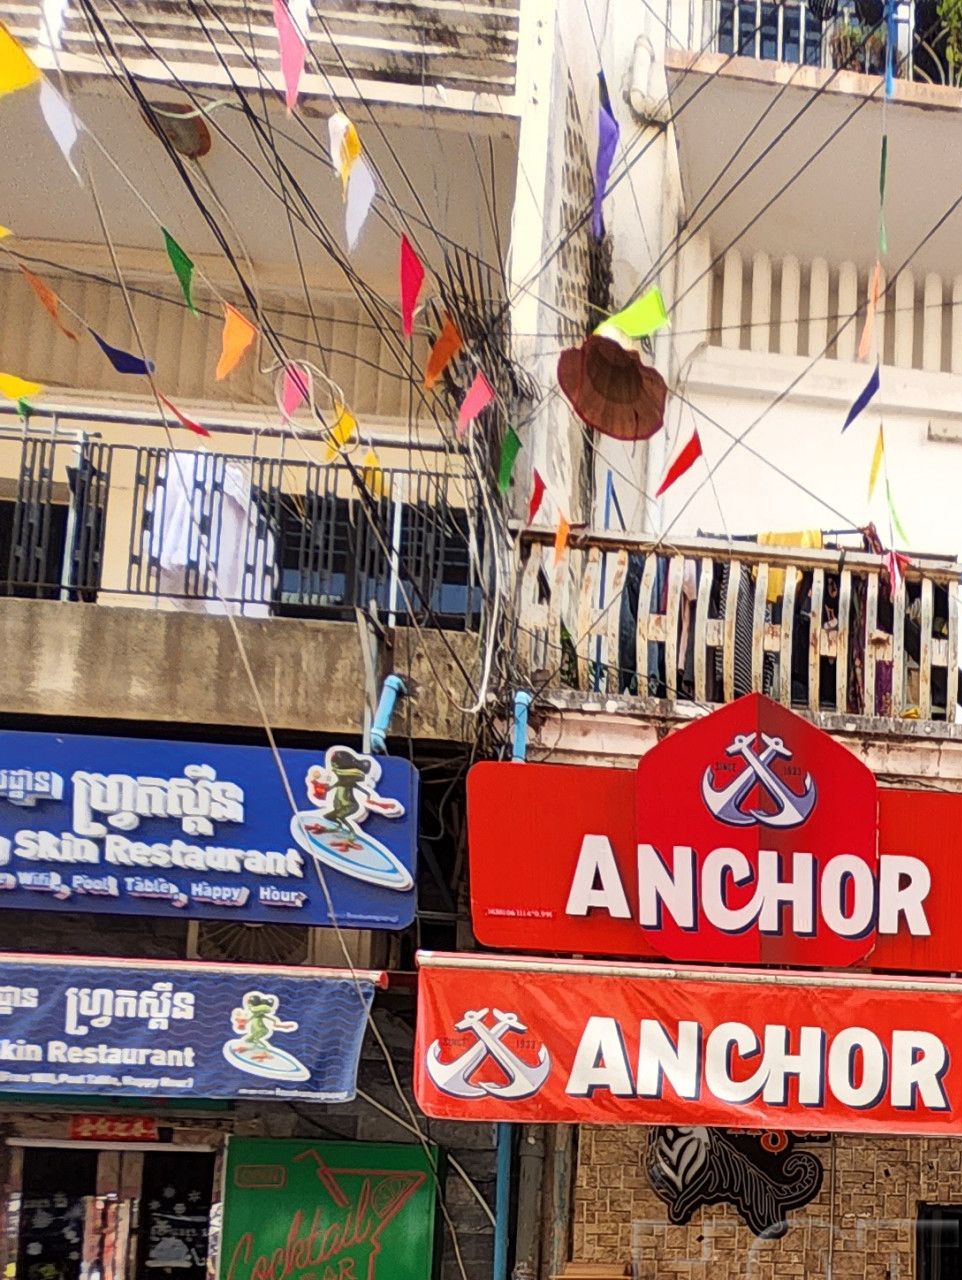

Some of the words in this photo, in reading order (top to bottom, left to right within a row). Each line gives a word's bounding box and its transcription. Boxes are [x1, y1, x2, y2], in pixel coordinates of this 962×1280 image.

[14, 829, 99, 864] Skin
[105, 833, 304, 878] Restaurant
[72, 874, 118, 896] Pool
[190, 881, 249, 907] Happy
[565, 834, 932, 939] ANCHOR
[0, 1039, 42, 1062] kin
[47, 1041, 195, 1068] Restaurant
[564, 1015, 951, 1112] ANCHOR
